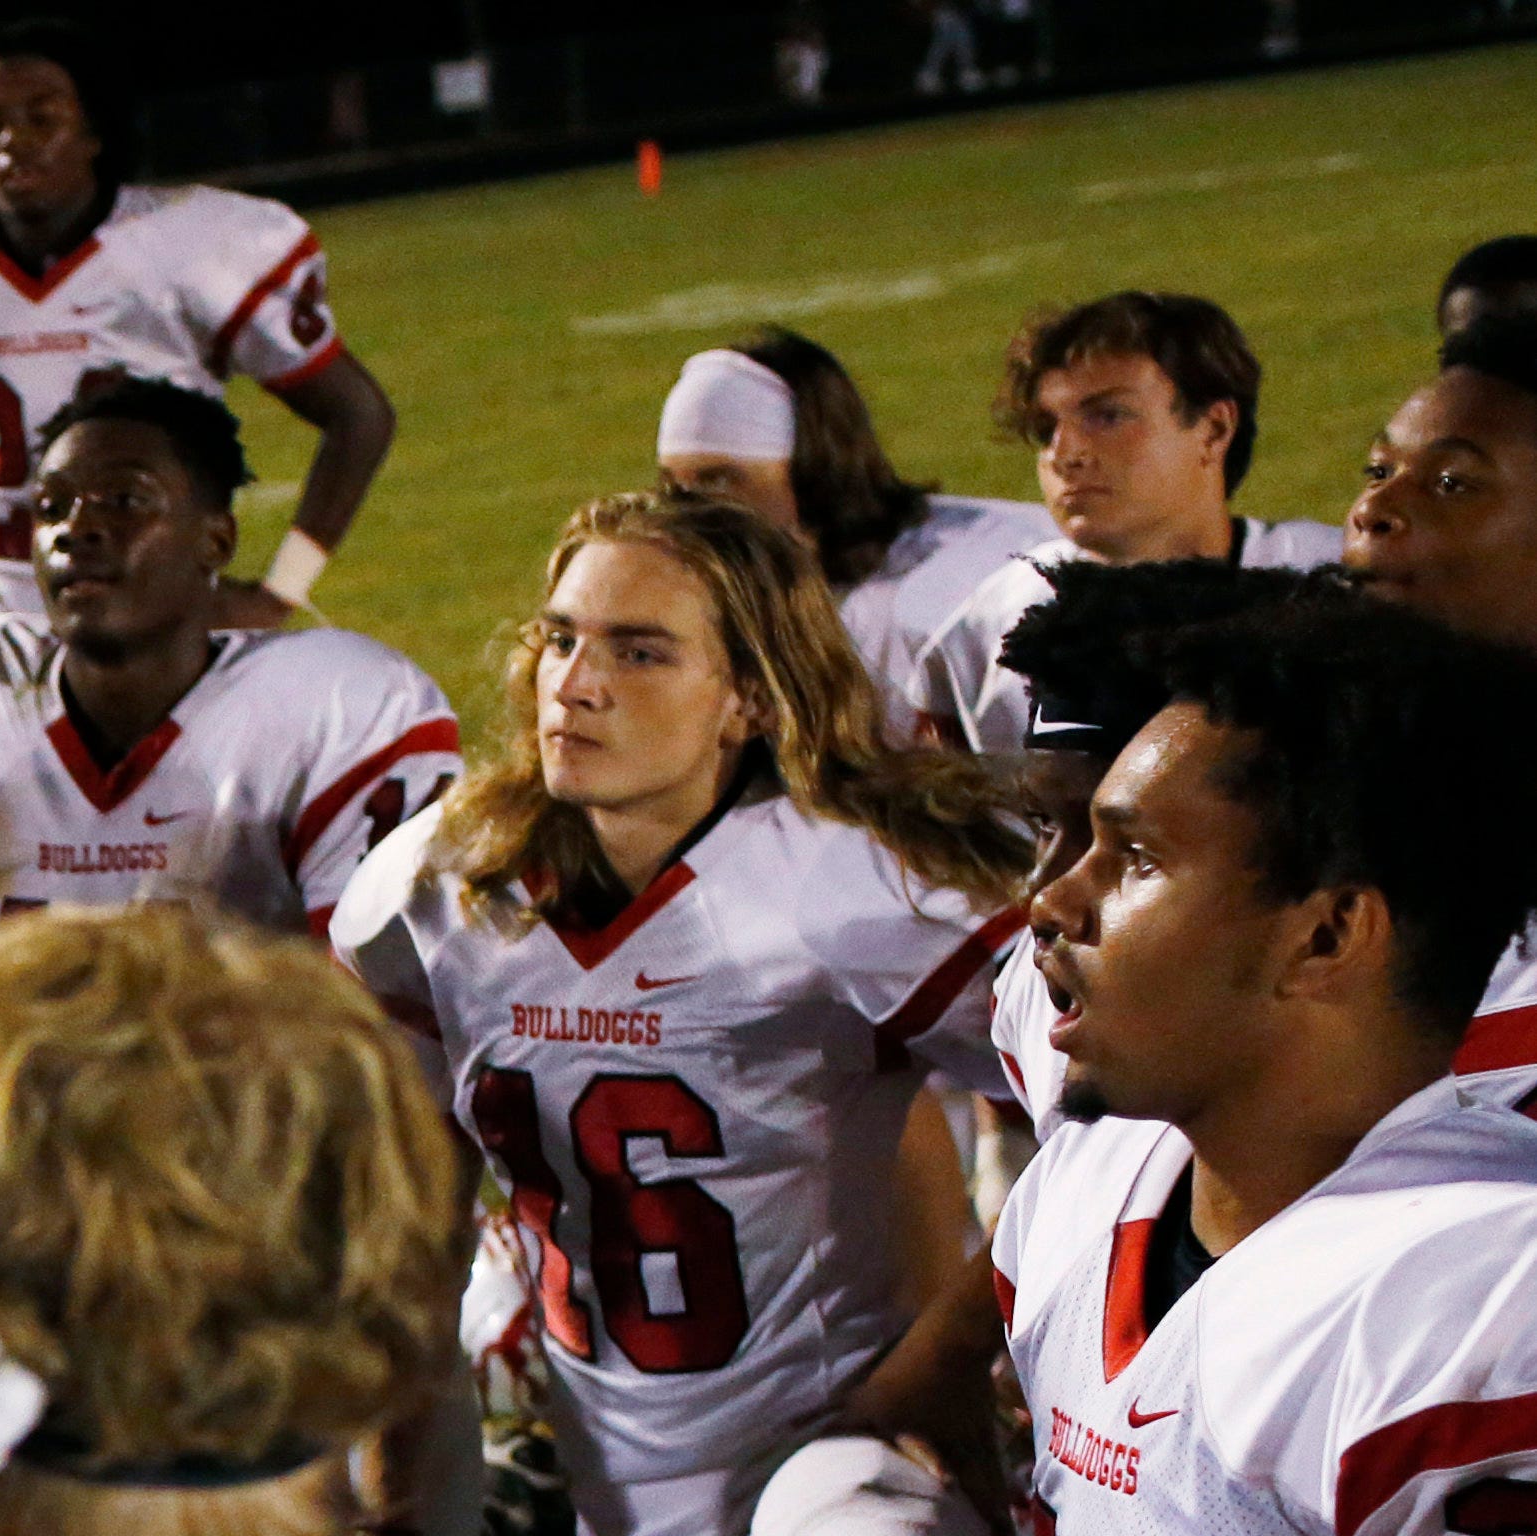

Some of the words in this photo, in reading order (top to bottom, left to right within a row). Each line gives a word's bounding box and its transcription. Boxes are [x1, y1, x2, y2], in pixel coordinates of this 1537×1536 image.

[511, 1003, 662, 1046] BULLDOGGS
[472, 1064, 749, 1374] 16
[1048, 1406, 1140, 1496] BULLDOGGS
